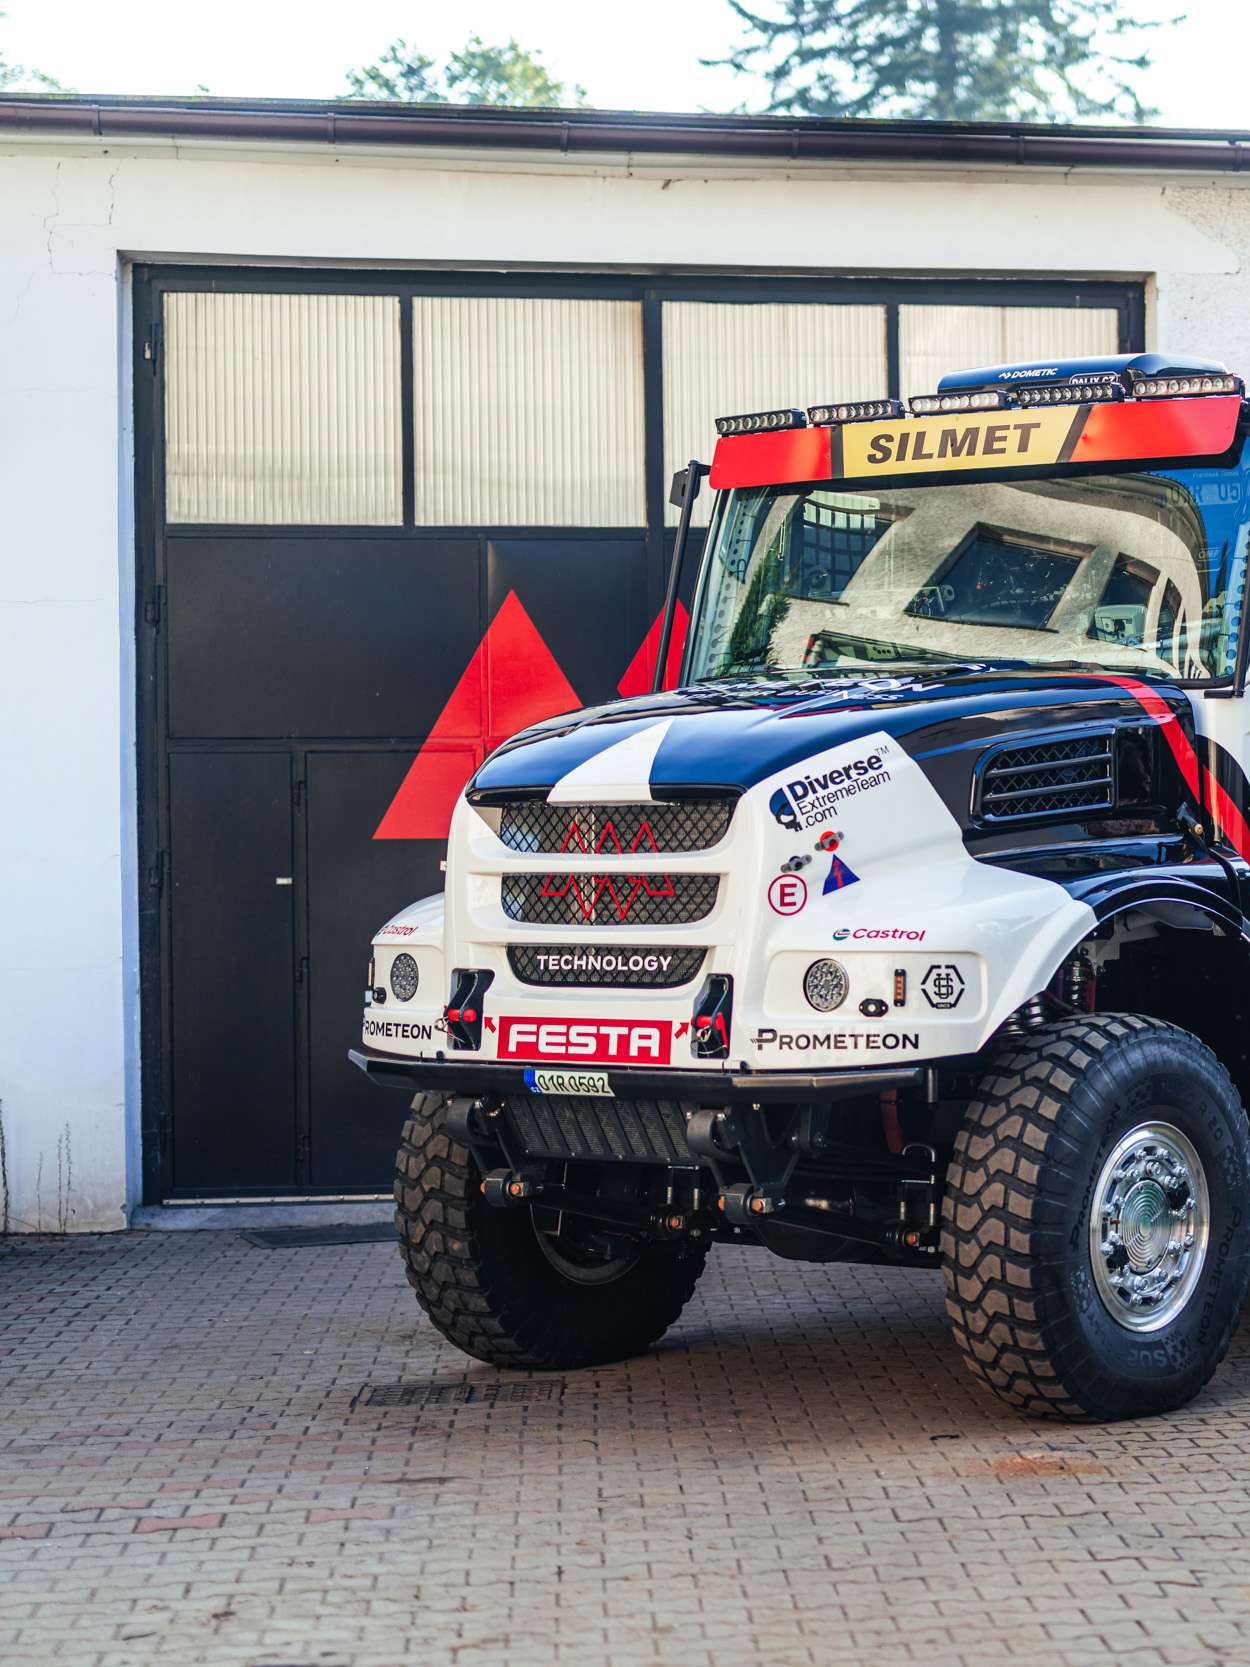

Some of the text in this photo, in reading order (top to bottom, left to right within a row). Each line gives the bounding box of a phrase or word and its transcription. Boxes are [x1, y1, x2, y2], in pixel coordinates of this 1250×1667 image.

[1011, 368, 1058, 378] DOMETIC
[867, 422, 1041, 465] SILMET
[786, 754, 884, 803] Diverse
[796, 769, 891, 816] ExtremeTeam
[805, 804, 838, 829] .com
[852, 928, 926, 942] Castrol
[536, 955, 672, 971] TECHNOLOGY
[365, 1020, 432, 1040] ROMETEON
[507, 1024, 660, 1057] FESTA
[750, 1028, 920, 1051] PROMETEON
[568, 1076, 611, 1094] 0592
